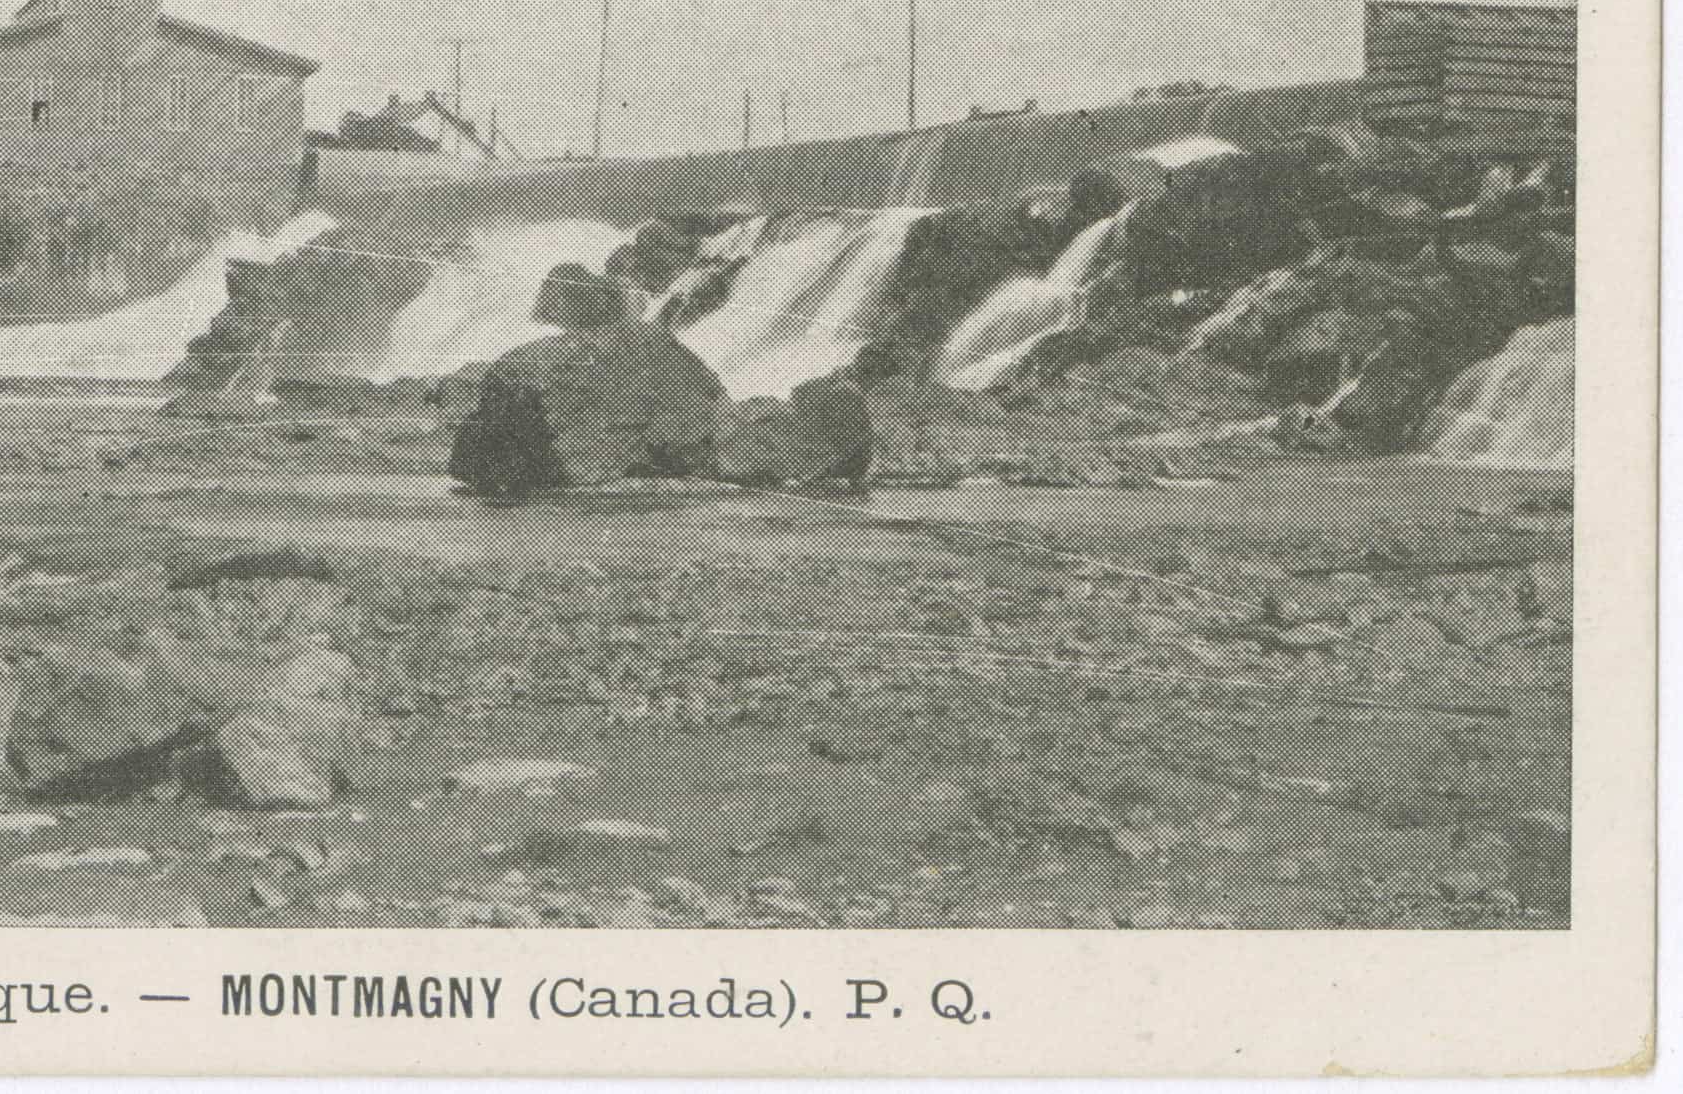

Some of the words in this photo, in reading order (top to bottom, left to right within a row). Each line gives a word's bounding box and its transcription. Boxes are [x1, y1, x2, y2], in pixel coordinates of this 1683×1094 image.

[221, 973, 503, 1019] MONTMAGNY
[528, 977, 811, 1028] (Canada).
[845, 979, 902, 1019] P.
[931, 979, 992, 1025] Q.
